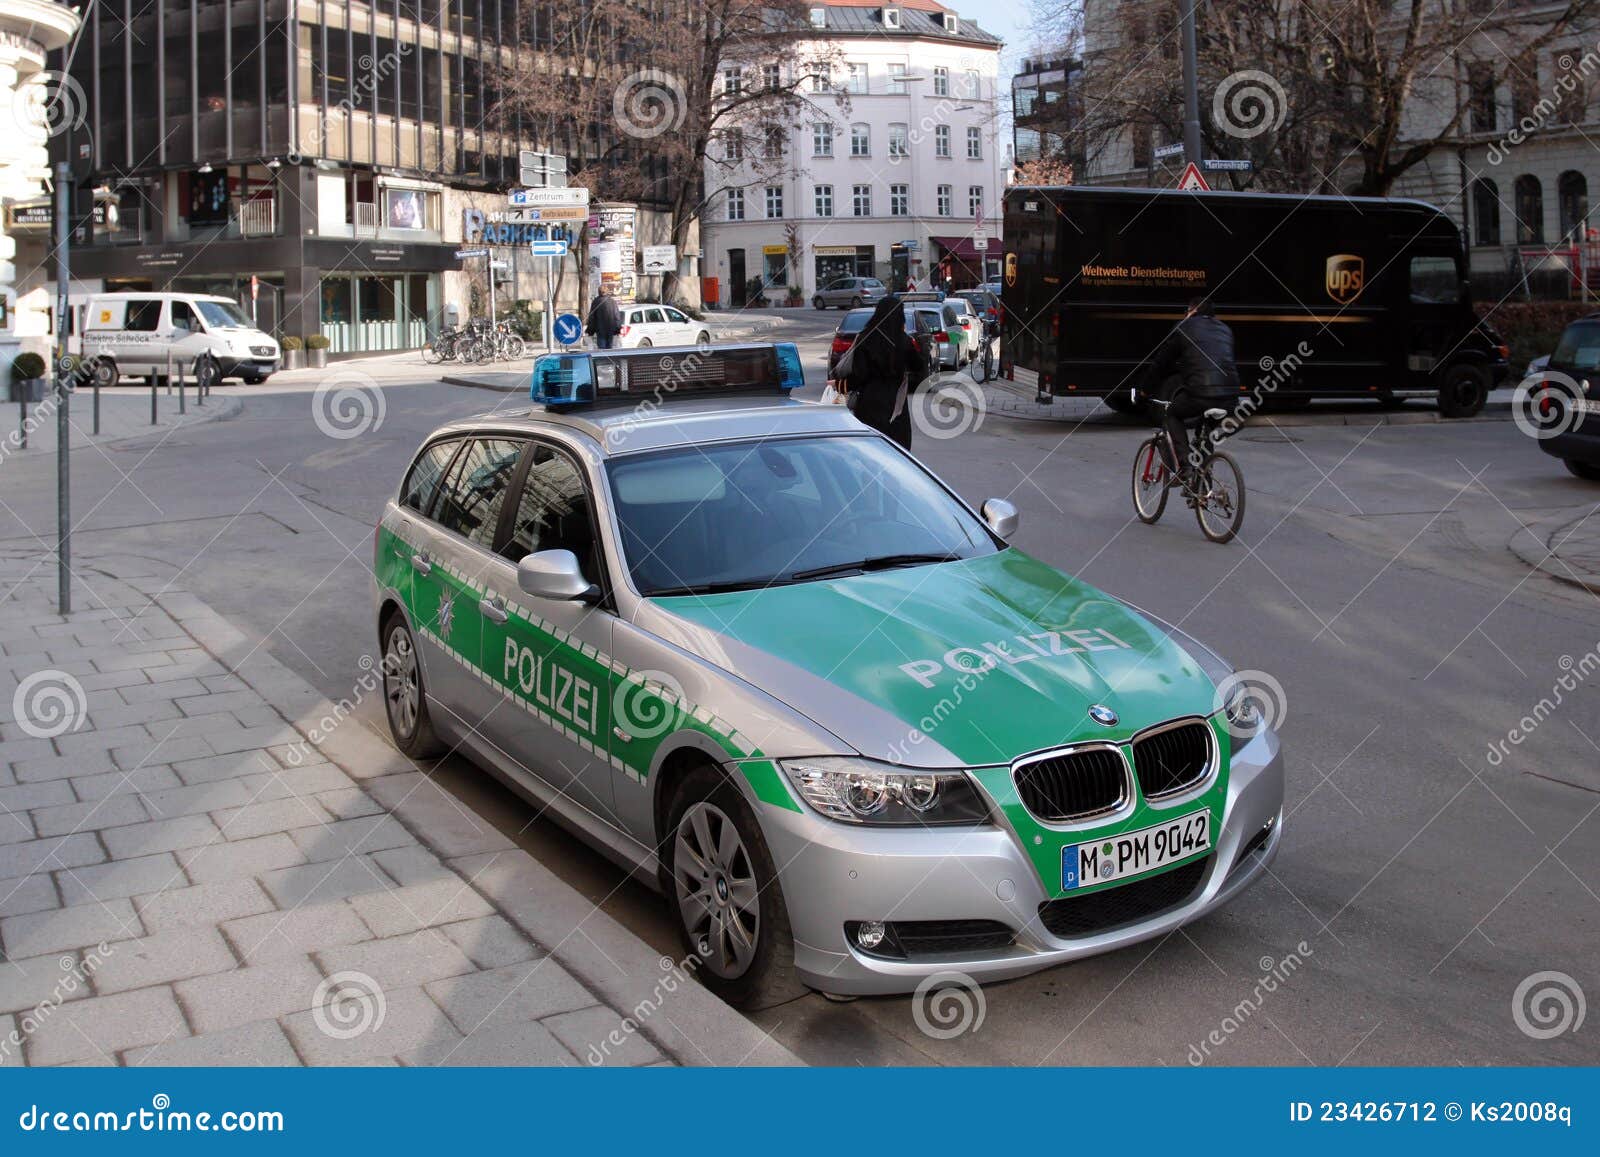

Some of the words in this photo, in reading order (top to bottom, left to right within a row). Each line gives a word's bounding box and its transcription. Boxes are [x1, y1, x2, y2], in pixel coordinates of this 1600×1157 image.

[1081, 265, 1128, 277] Weltweite
[1131, 266, 1206, 280] Dienstleistungen
[1328, 270, 1361, 297] ups
[504, 637, 598, 735] POLIZEI
[900, 628, 1133, 689] POLIZEI
[1081, 846, 1098, 881] M
[1117, 834, 1150, 873] PM
[1154, 815, 1206, 862] 9042
